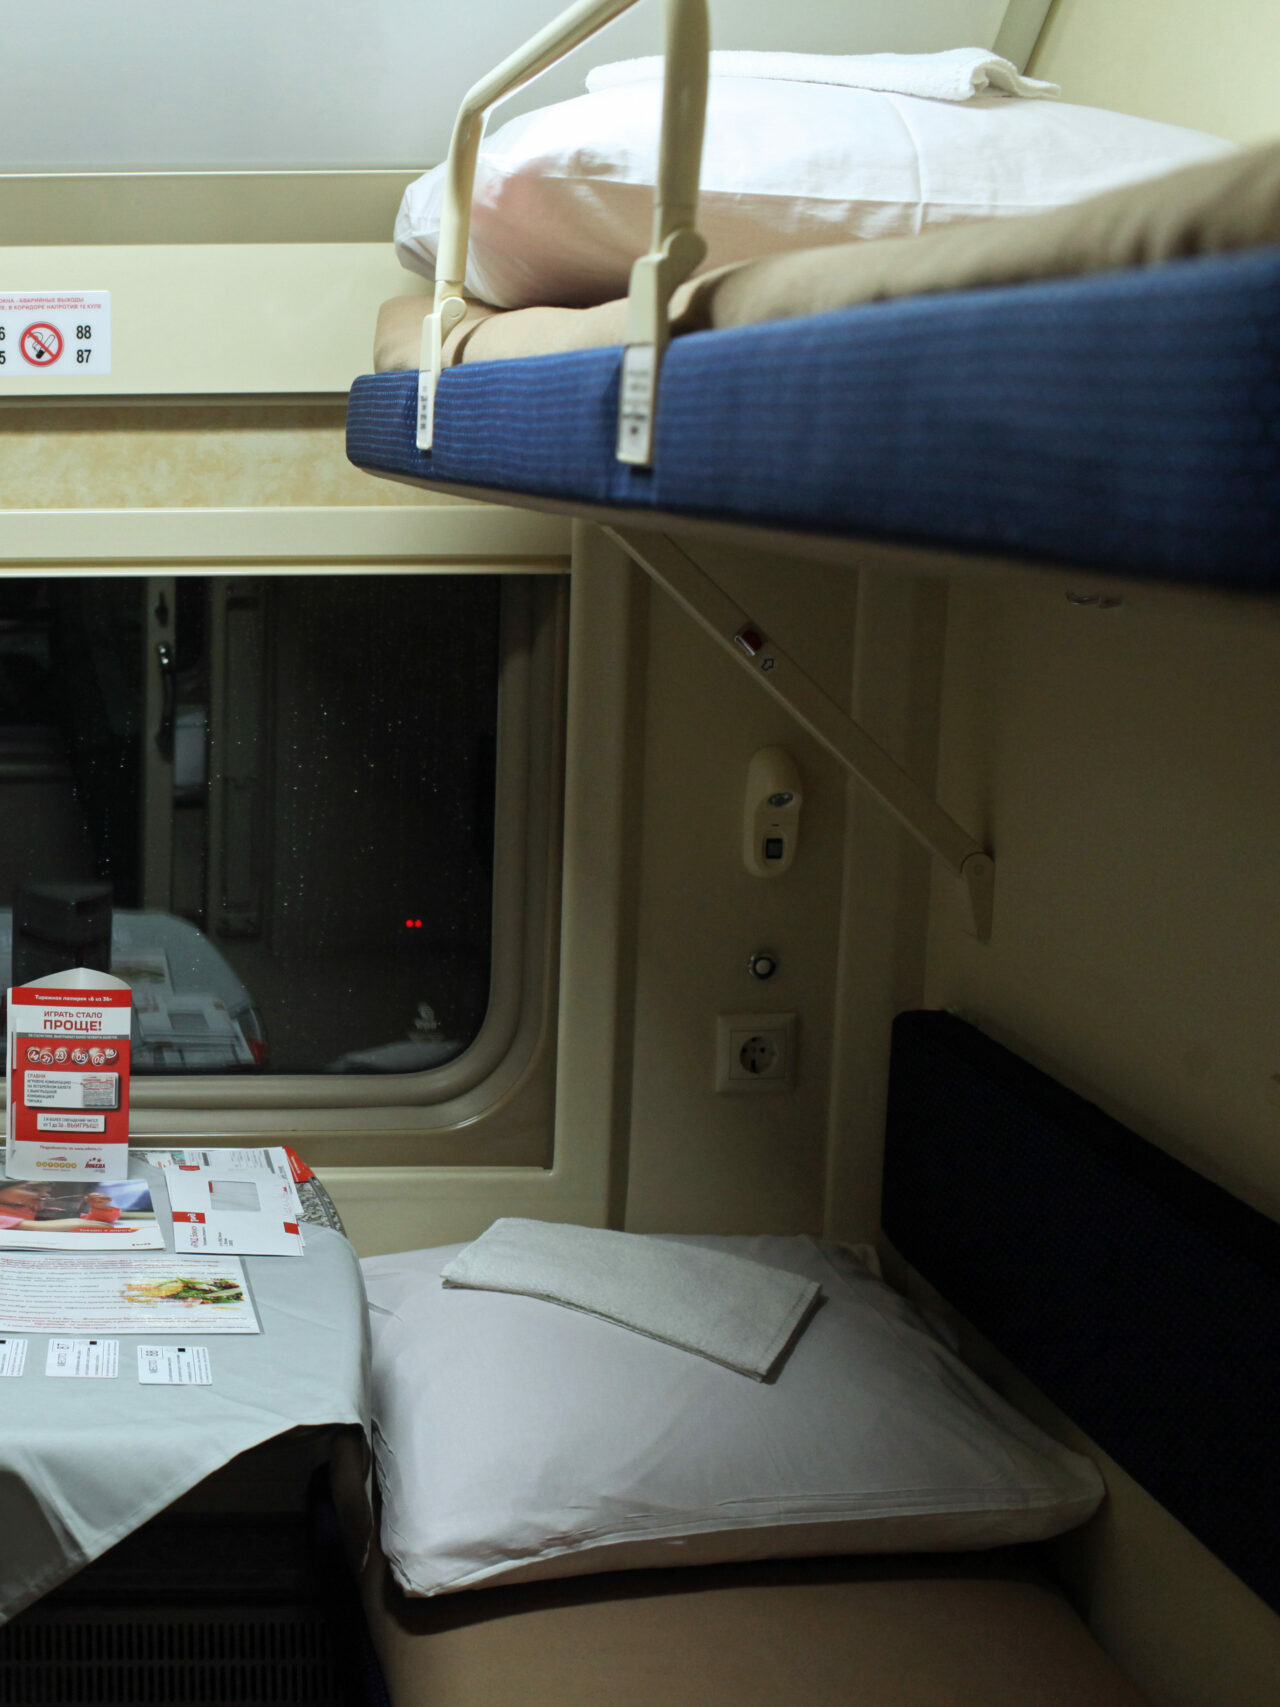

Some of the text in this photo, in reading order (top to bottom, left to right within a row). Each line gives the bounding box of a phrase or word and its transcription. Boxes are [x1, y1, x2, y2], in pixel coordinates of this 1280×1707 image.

[76, 325, 91, 339] 88
[76, 349, 92, 363] 87
[43, 1019, 102, 1032] ПРОЩЕ!
